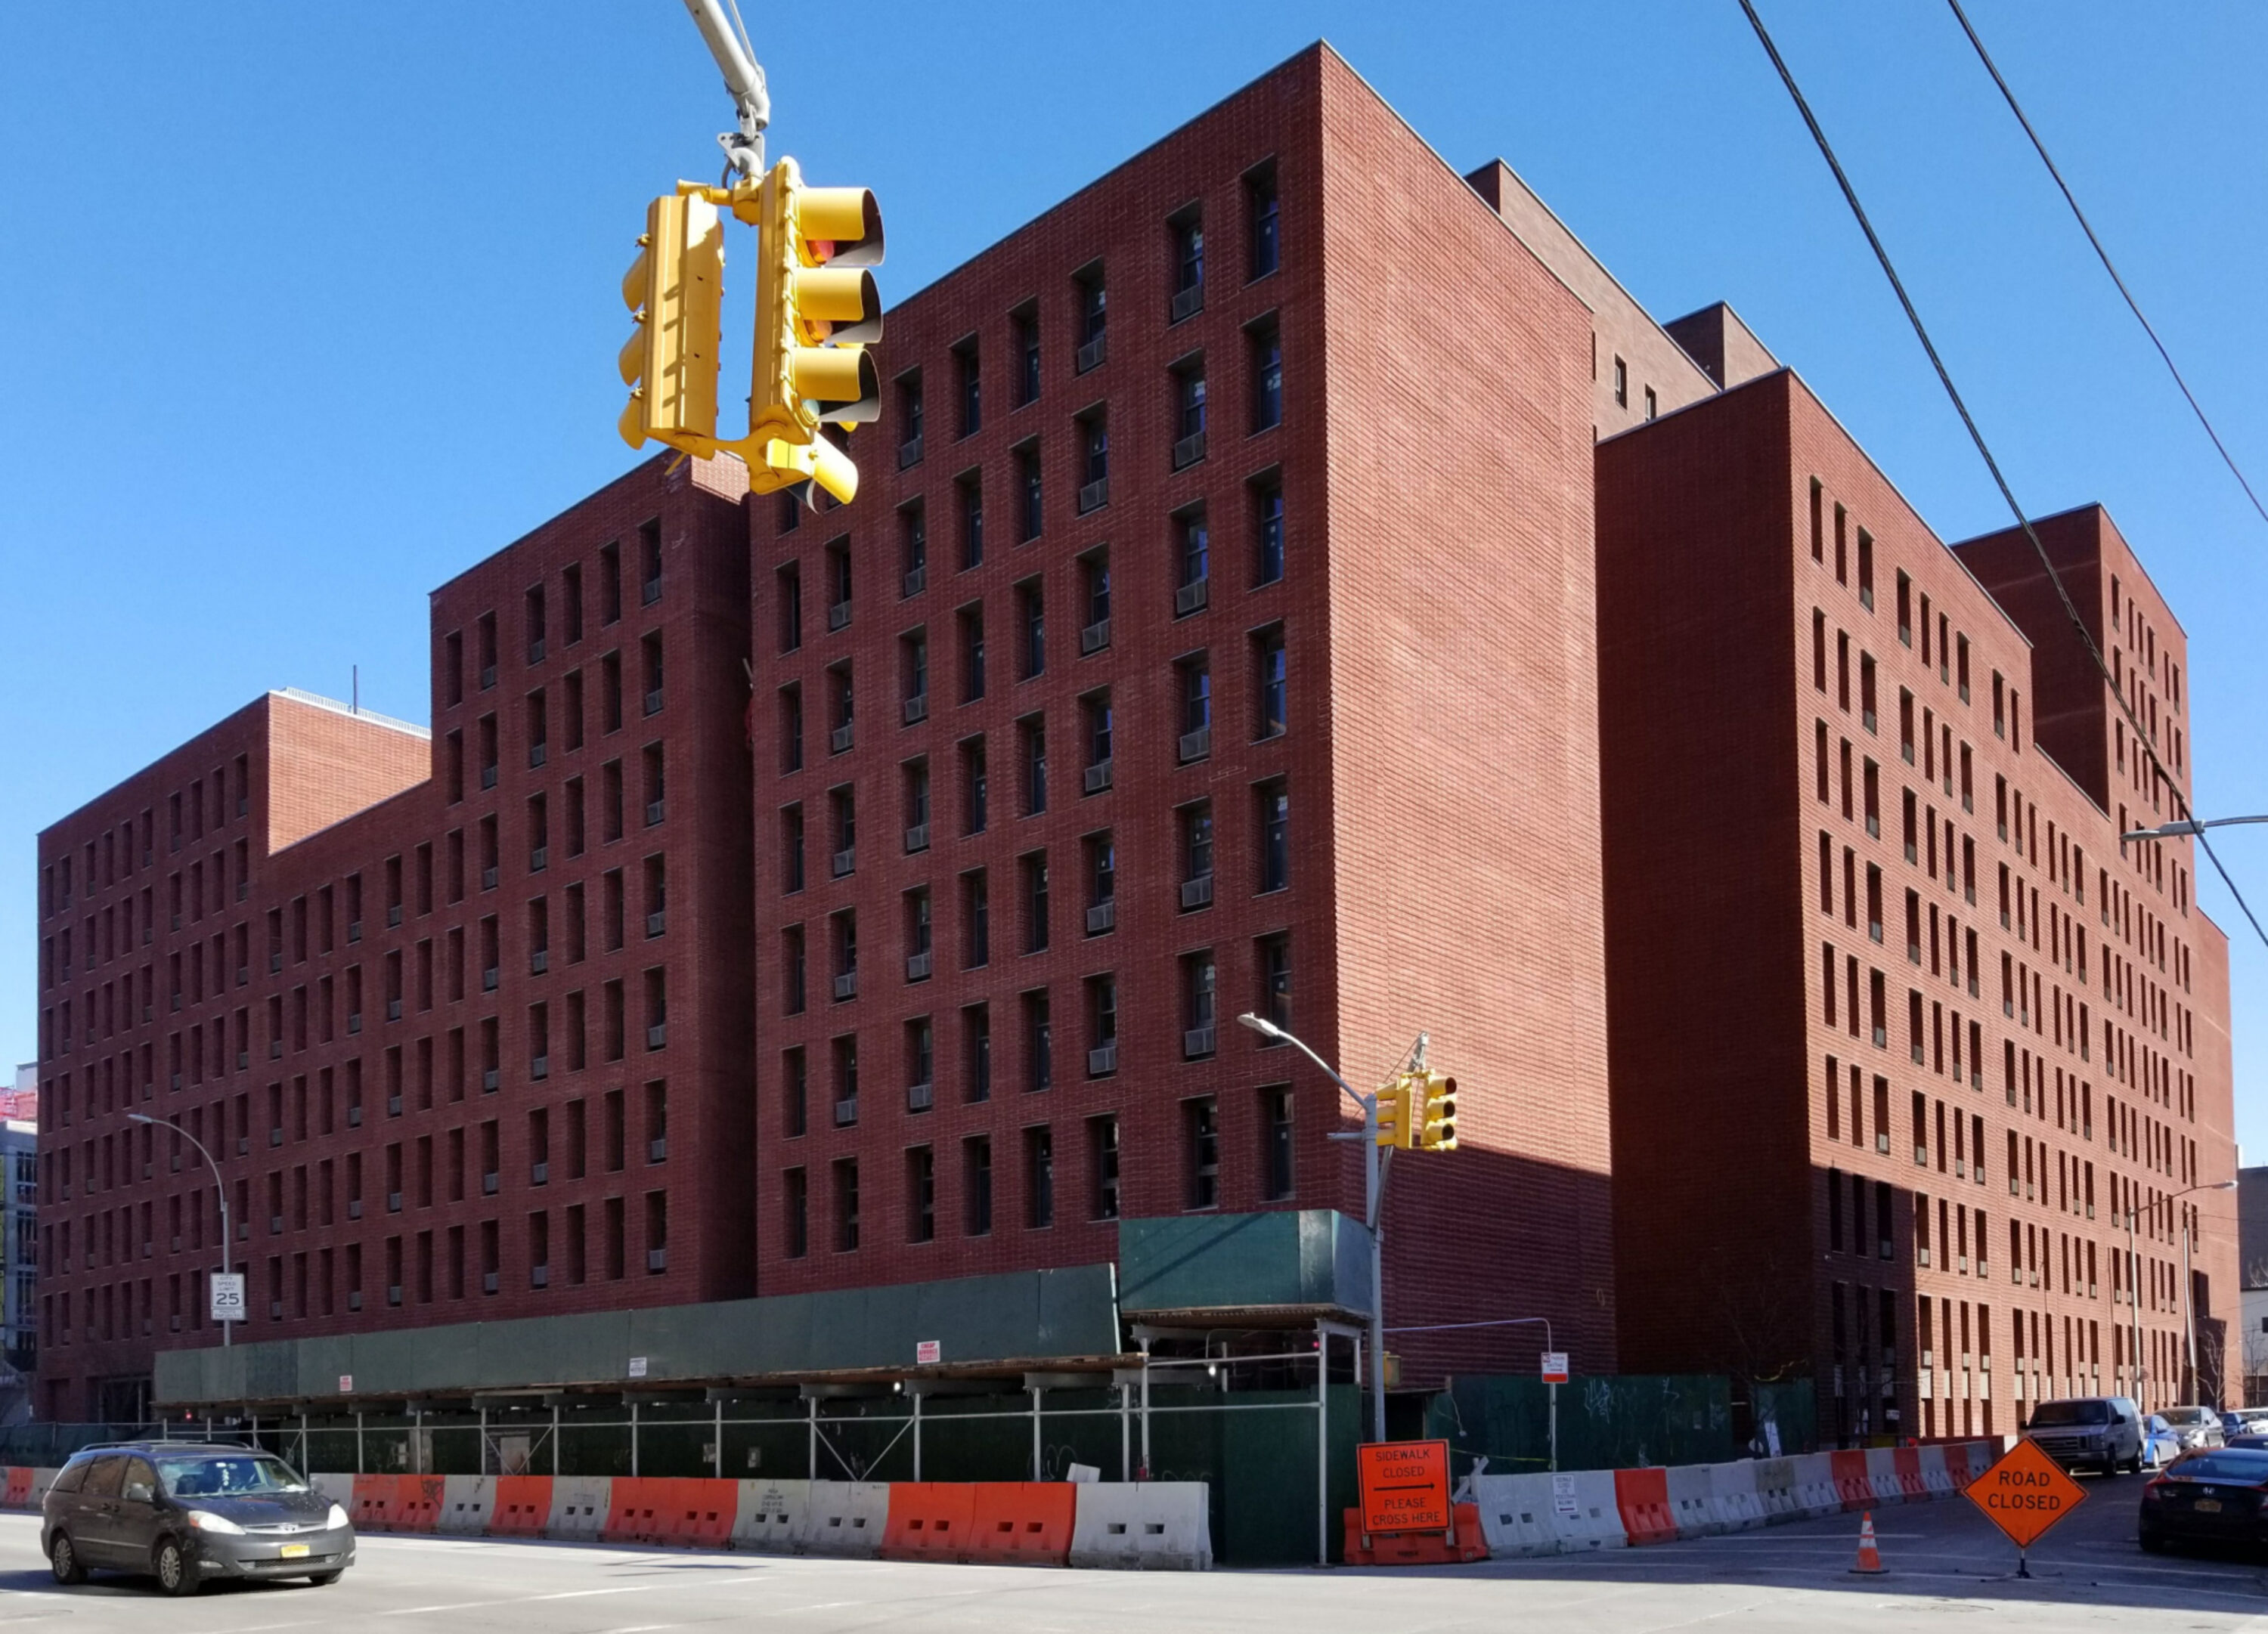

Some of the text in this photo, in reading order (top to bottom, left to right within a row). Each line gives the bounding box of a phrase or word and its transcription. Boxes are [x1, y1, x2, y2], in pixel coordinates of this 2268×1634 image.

[216, 1293, 240, 1305] 25
[1375, 1449, 1430, 1462] SIDEWALK
[1383, 1466, 1424, 1478] CLOSED
[1999, 1471, 2050, 1487] ROAD
[1384, 1497, 1426, 1510] PLEASE
[1988, 1493, 2060, 1510] CLOSED
[1372, 1512, 1440, 1526] CROSS HERE
